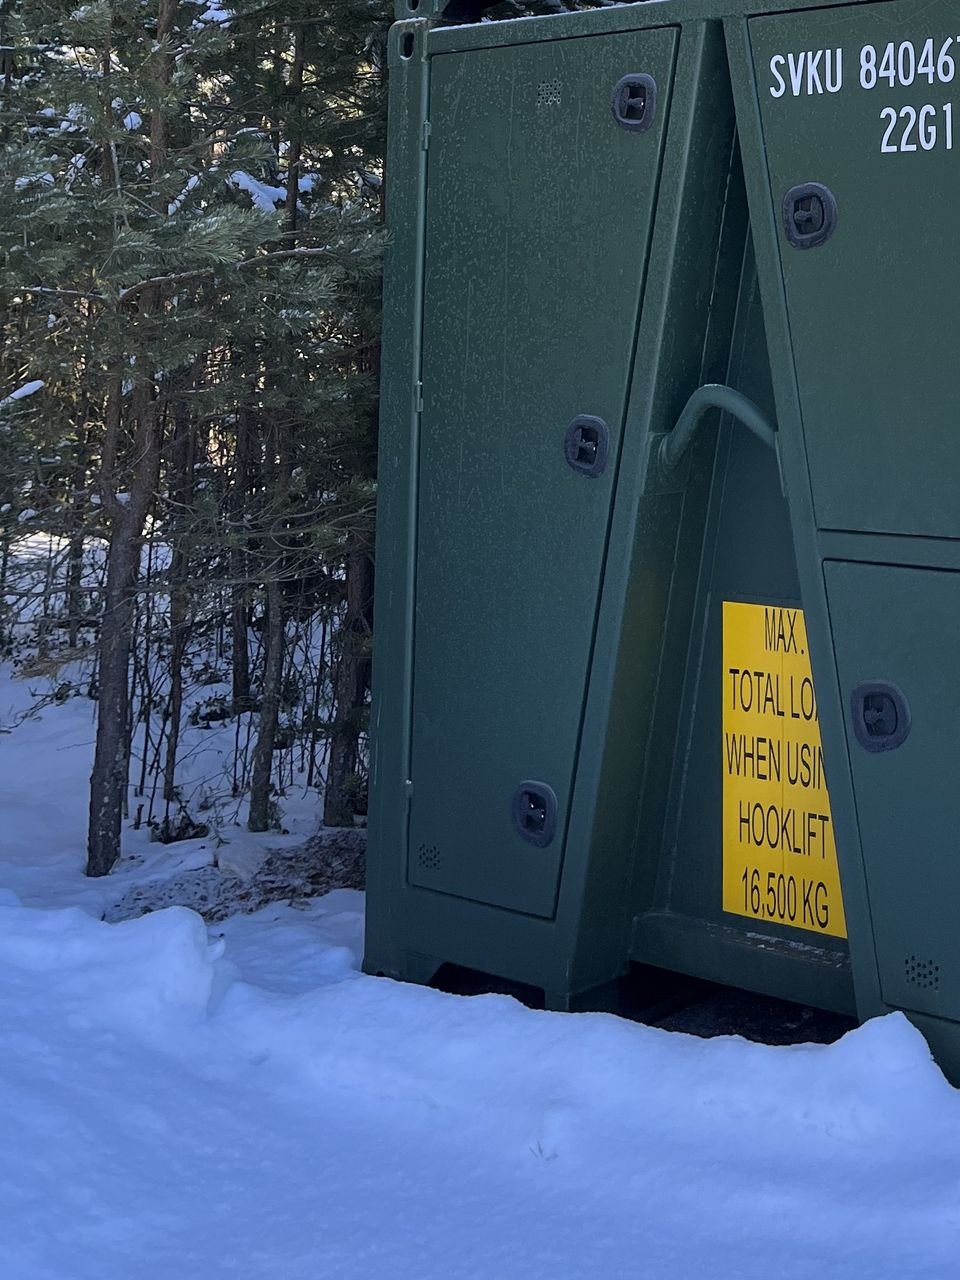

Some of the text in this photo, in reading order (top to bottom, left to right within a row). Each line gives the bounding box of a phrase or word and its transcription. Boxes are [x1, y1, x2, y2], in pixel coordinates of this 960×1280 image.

[769, 48, 843, 98] SVKU
[879, 102, 953, 153] 22G1
[764, 607, 805, 656] MAX.
[729, 668, 819, 722] TOTAL LO
[726, 732, 780, 782] WHEN
[738, 800, 830, 860] HOOKLIFT
[741, 866, 829, 929] 16,500 KG
